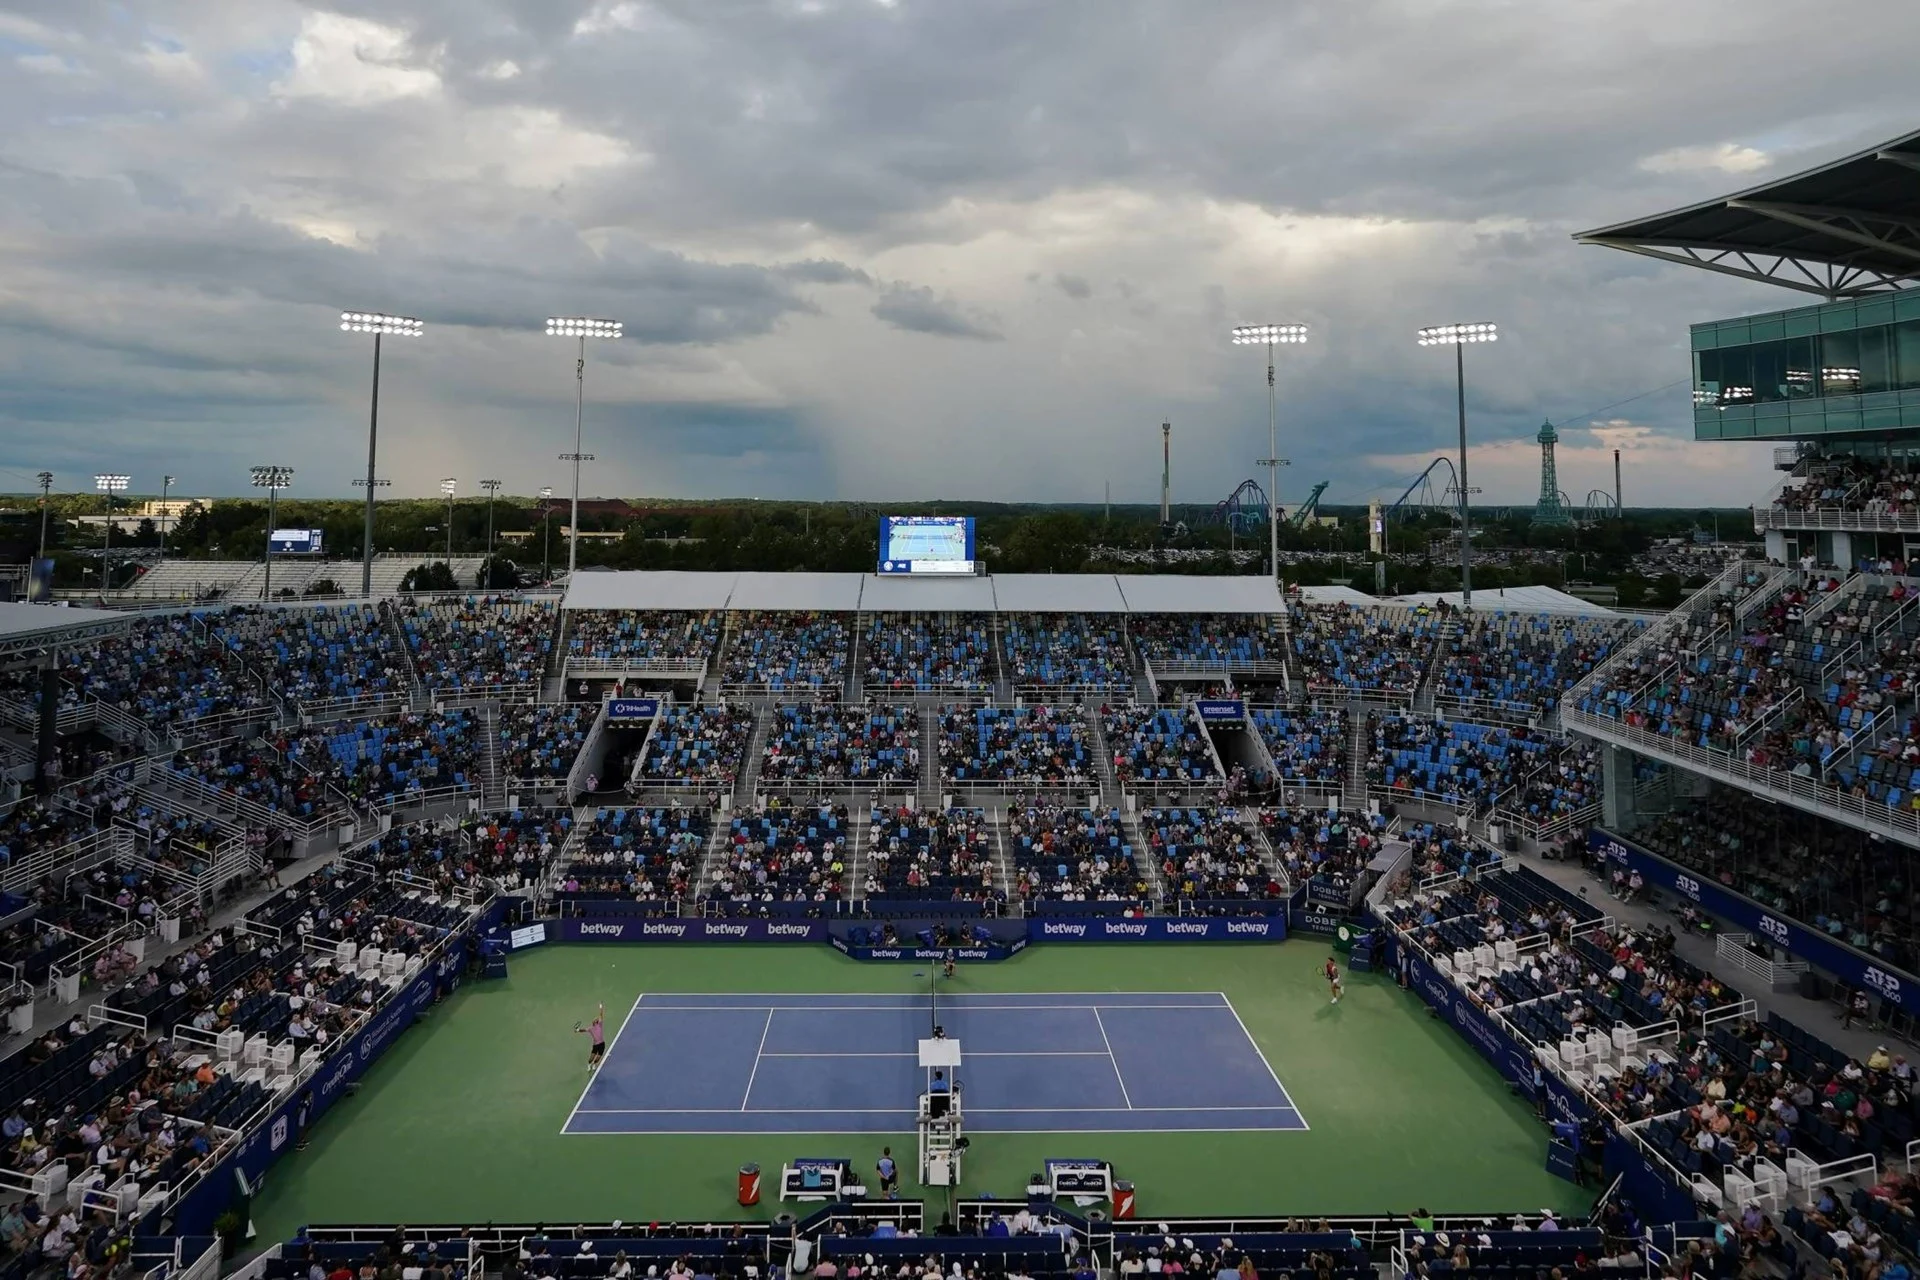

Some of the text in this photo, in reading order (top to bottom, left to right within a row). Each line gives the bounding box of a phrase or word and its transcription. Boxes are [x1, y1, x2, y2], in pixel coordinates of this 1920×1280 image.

[1607, 841, 1627, 857] ATP
[1676, 874, 1699, 891] ATP
[1305, 915, 1336, 926] DOBE
[1759, 915, 1788, 935] ATP
[580, 922, 811, 937] betway betway betway betway
[1044, 921, 1269, 936] betway betway betway betway
[1011, 939, 1026, 952] betway
[1774, 935, 1789, 947] 1000
[872, 949, 988, 959] betway betway betway
[1863, 966, 1900, 990] ATP
[1882, 987, 1901, 1003] 1000
